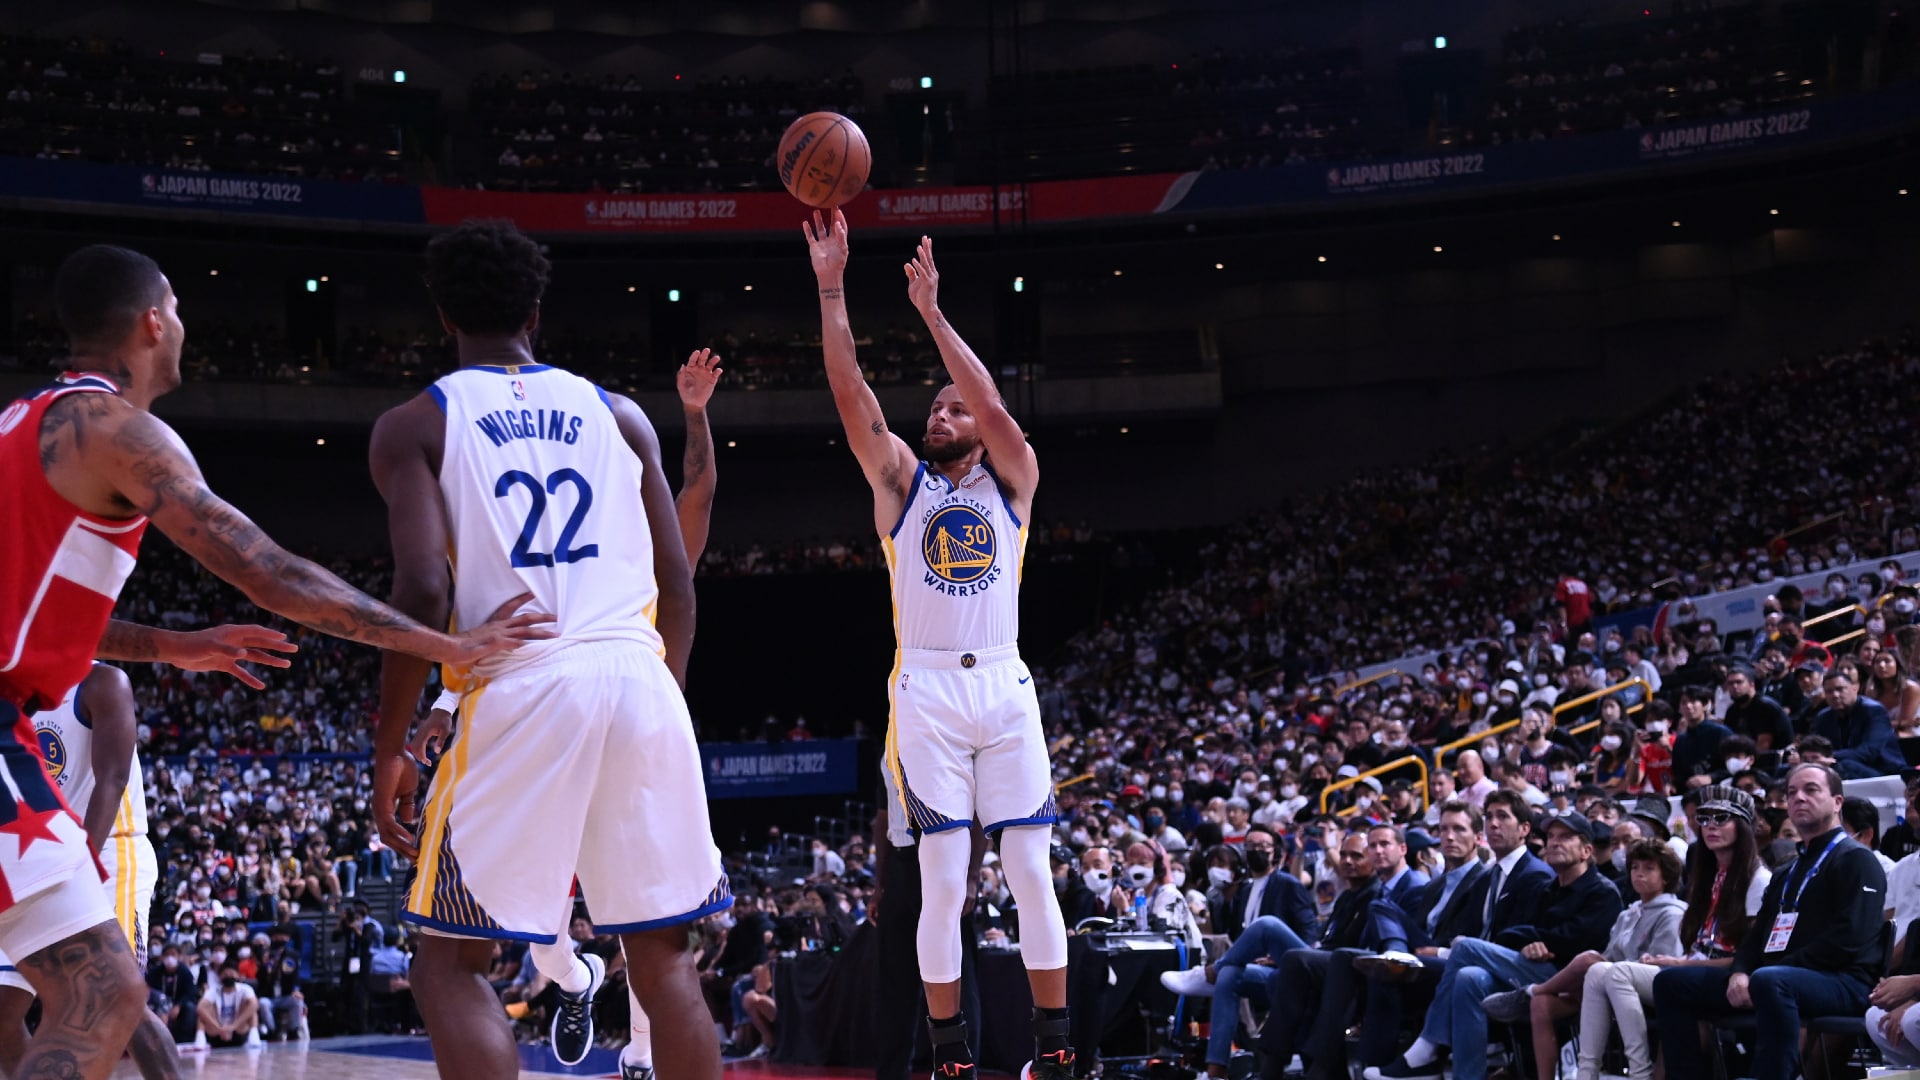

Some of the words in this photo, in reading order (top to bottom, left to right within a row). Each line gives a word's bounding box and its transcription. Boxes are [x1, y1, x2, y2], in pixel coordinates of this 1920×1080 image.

[1655, 126, 1708, 151] JAPAN
[1710, 117, 1764, 144] GAMES
[1766, 109, 1812, 136] 2022
[781, 131, 815, 186] Wilson
[1341, 164, 1390, 187] JAPAN
[1392, 157, 1441, 181] GAMES
[1443, 153, 1485, 176] 2022
[157, 175, 208, 195] JAPAN
[209, 178, 260, 199] GAMES
[261, 181, 302, 202] 2022
[892, 195, 939, 214] JAPAN
[941, 193, 987, 212] GAMES
[600, 200, 647, 219] JAPAN
[649, 200, 696, 219] GAMES
[697, 199, 737, 218] 2022
[475, 409, 583, 448] WIGGINS
[494, 467, 599, 568] 22
[922, 495, 959, 525] GOLDEN
[962, 498, 992, 518] STATE
[961, 524, 988, 546] 30
[923, 565, 1001, 597] WARRIORS
[49, 741, 58, 760] 5
[721, 756, 758, 777] JAPAN
[759, 754, 796, 775] GAMES
[796, 751, 828, 774] 2022
